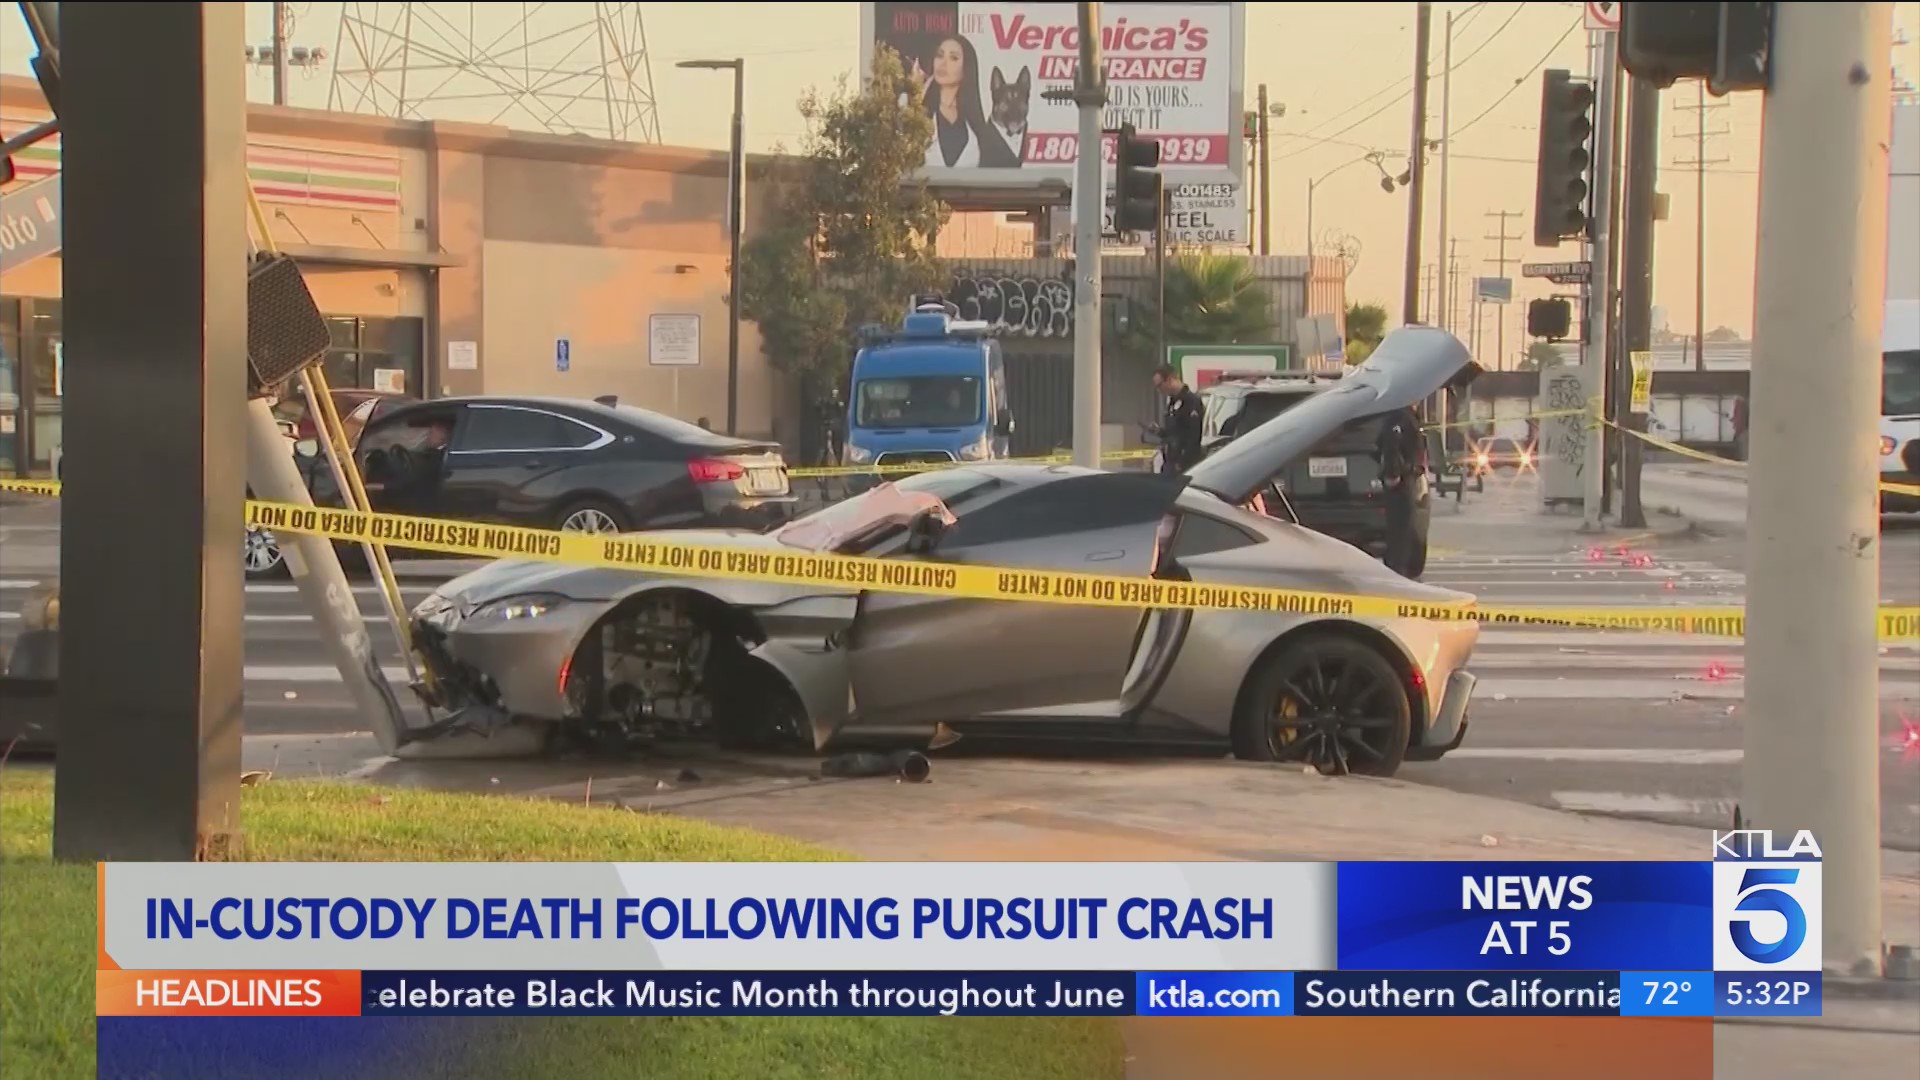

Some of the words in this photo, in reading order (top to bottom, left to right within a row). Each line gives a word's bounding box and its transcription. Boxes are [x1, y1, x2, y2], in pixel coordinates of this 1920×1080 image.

[961, 13, 984, 34] LIFE
[1045, 57, 1202, 79] INRANCE
[1128, 86, 1141, 106] IS
[1145, 86, 1203, 107] YOURS...
[1148, 108, 1162, 130] IT
[1166, 211, 1214, 229] TEEL
[0, 214, 37, 255] oto
[1197, 229, 1236, 243] SCALE
[250, 504, 287, 527] NOT
[291, 509, 316, 530] DO
[321, 512, 366, 536] AREA
[371, 518, 480, 548] RESTRICTED
[483, 528, 561, 556] CAUTION
[604, 540, 655, 565] ENTER
[659, 544, 694, 568] NOT
[699, 548, 722, 571] DO
[726, 551, 770, 575] AREA
[774, 556, 876, 583] RESTRICTED
[882, 563, 957, 589] CAUTION
[998, 573, 1049, 596] ENTER
[1053, 576, 1087, 599] NOT
[1092, 579, 1115, 601] DO
[1120, 580, 1163, 603] AREA
[1168, 585, 1271, 611] RESTRICTED
[1276, 596, 1353, 615] CAUTION
